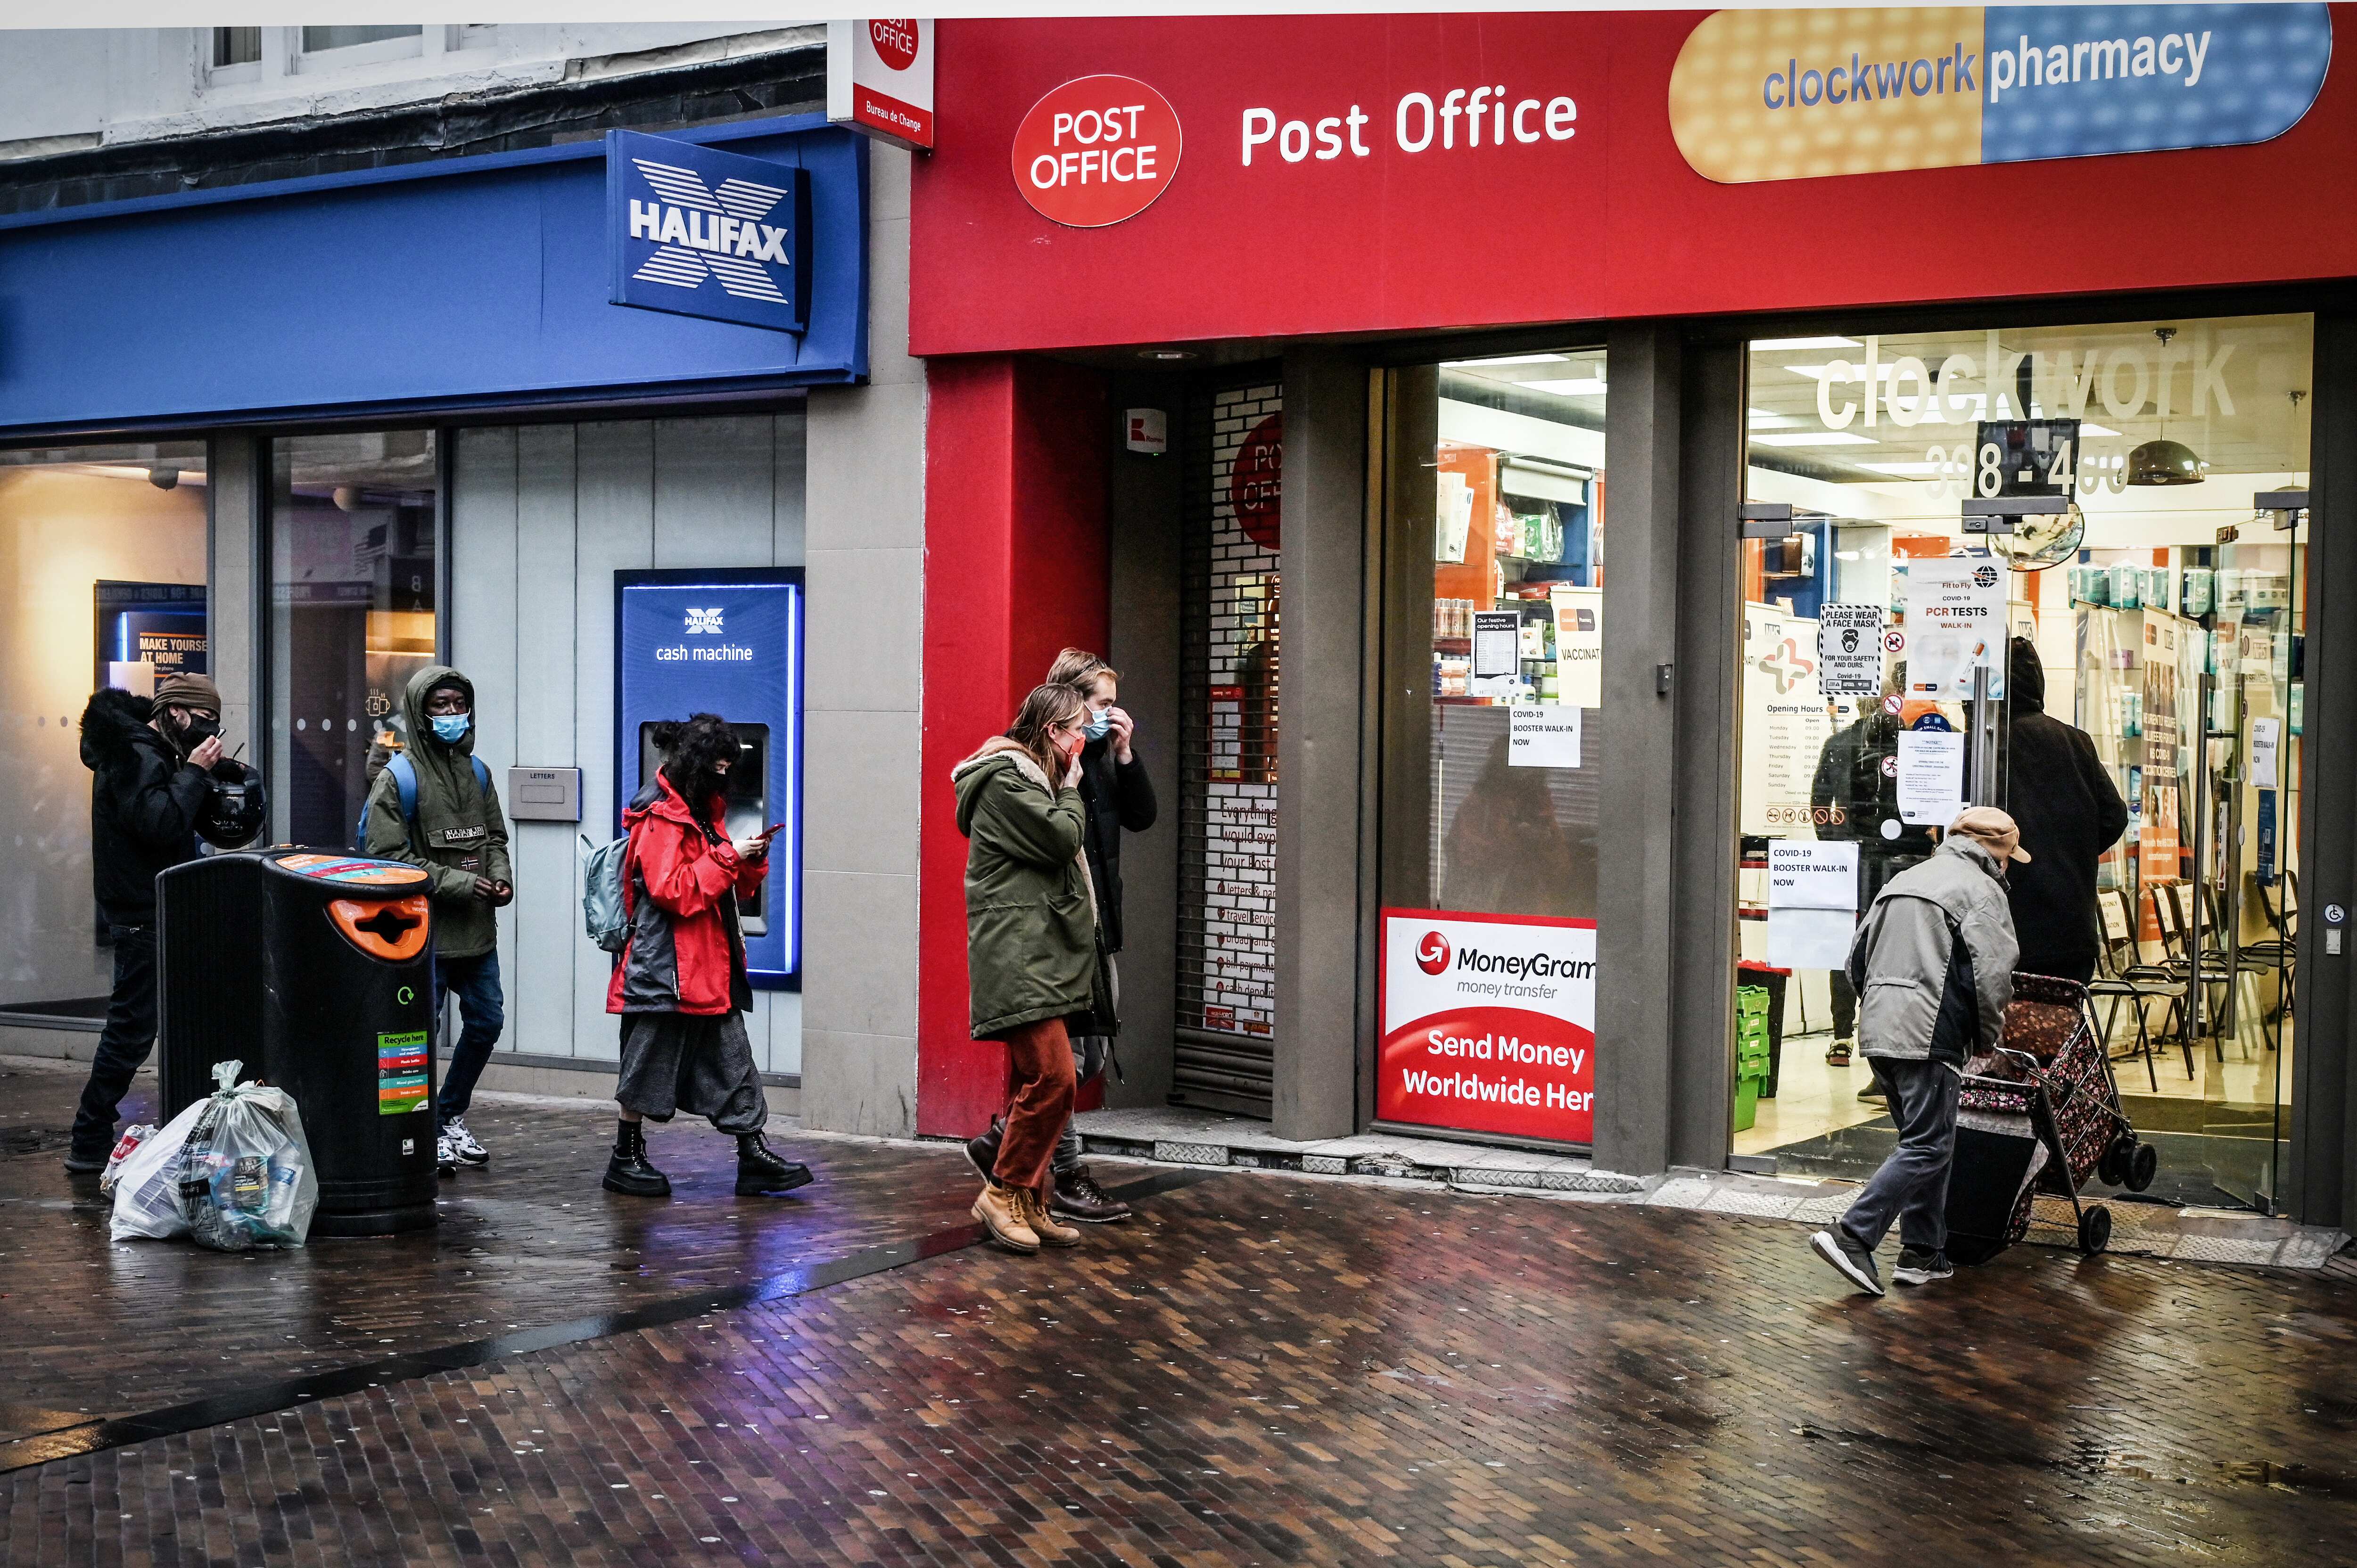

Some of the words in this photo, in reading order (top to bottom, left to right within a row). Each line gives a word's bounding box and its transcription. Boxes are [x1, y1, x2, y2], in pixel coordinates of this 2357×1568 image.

[874, 22, 912, 55] OFFICE
[1763, 42, 1977, 110] clockwork
[1990, 31, 2211, 103] pharmacy
[866, 100, 888, 119] Bureau
[890, 110, 898, 123] de
[899, 113, 921, 132] Change
[1242, 104, 1370, 166] Post
[1396, 84, 1577, 153] Office
[1054, 105, 1145, 147] POST
[1030, 145, 1156, 189] OFFICE
[630, 199, 790, 265] HALIFAX
[1816, 330, 2236, 430] clockwork
[1925, 443, 2002, 501] 398
[685, 616, 724, 625] HALIFAX
[1926, 607, 1949, 616] PCR
[1951, 607, 1987, 616] TESTS
[140, 638, 167, 650] MAKE
[170, 639, 207, 652] YOURSE
[656, 644, 688, 660] cash
[693, 643, 753, 660] machine
[140, 652, 154, 662] AT
[156, 652, 183, 664] HOME
[1767, 705, 1798, 714] Opening
[1222, 803, 1277, 824] Everything
[1222, 828, 1253, 843] would
[1223, 857, 1245, 872] your
[1228, 883, 1252, 895] letters
[1255, 886, 1260, 895] &
[1227, 910, 1248, 922] travel
[1252, 913, 1275, 924] ervic
[1458, 948, 1596, 981] MoneyGram
[1226, 983, 1242, 992] cah
[1245, 984, 1274, 1000] depoit
[1457, 981, 1502, 998] money
[1504, 983, 1558, 999] transfer
[385, 1035, 410, 1045] Recycle
[1428, 1029, 1492, 1059] Send
[1498, 1035, 1585, 1074] Money
[1402, 1068, 1541, 1106] Worldwide
[1546, 1083, 1594, 1111] Her
